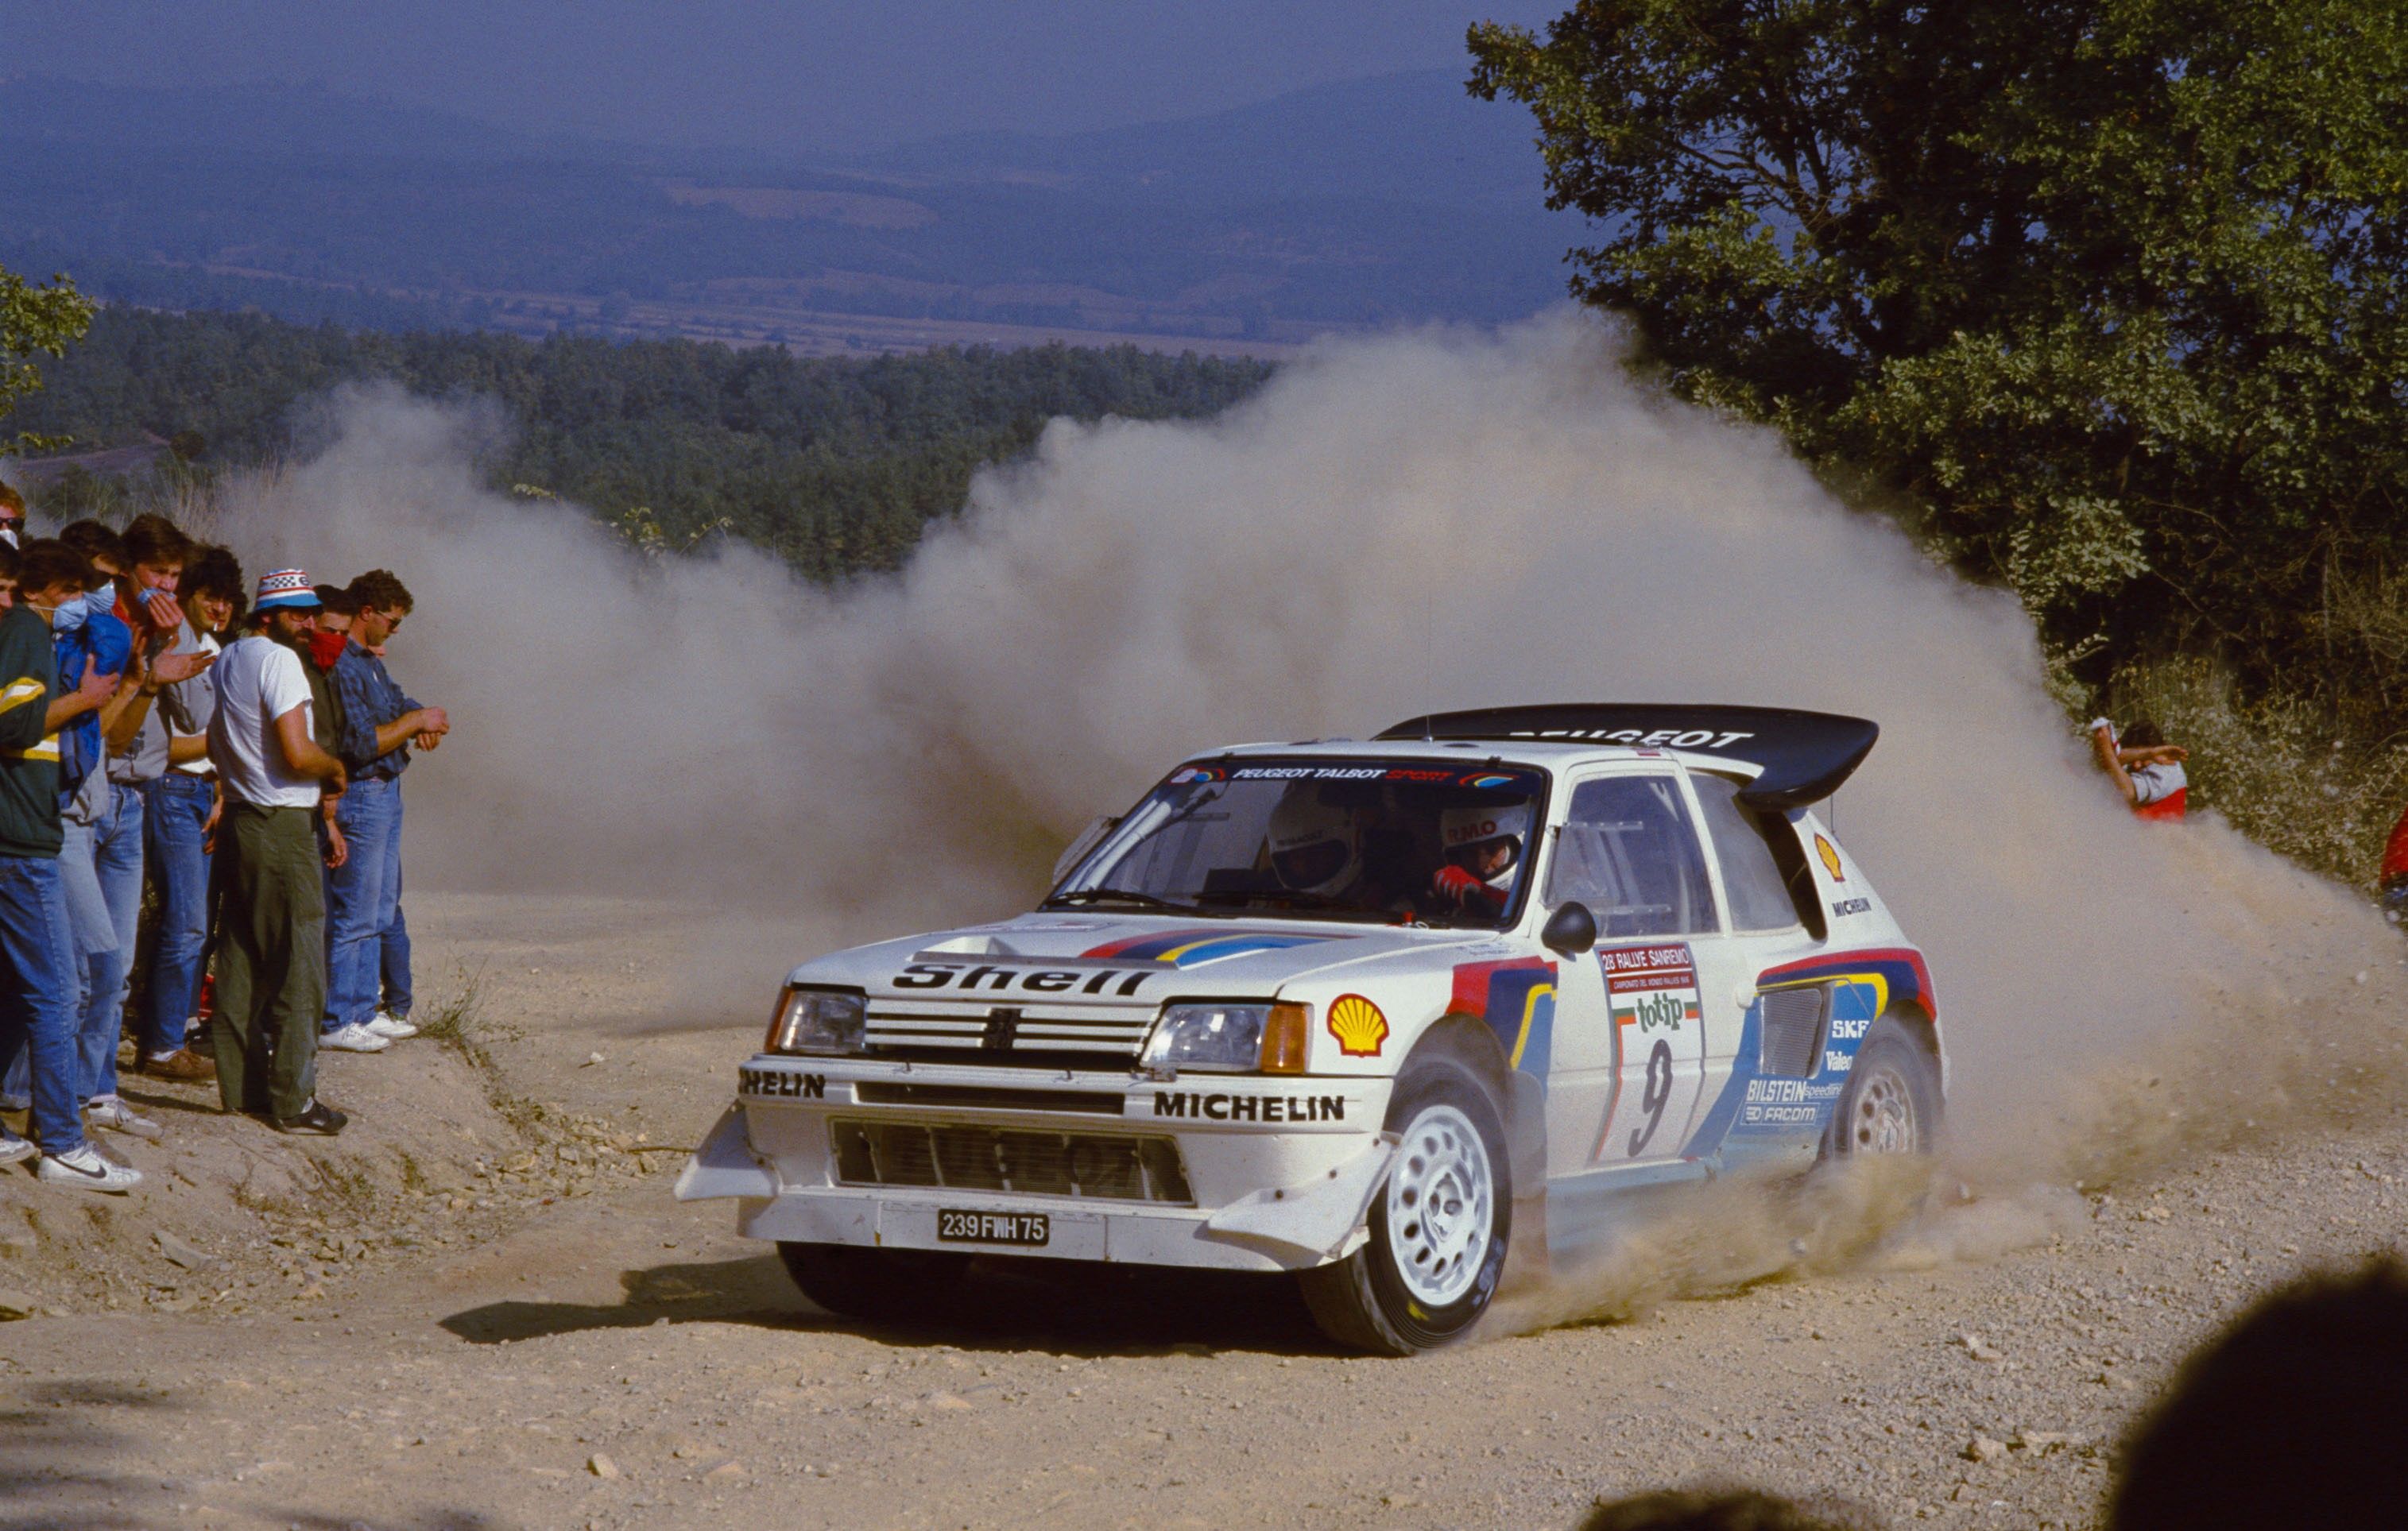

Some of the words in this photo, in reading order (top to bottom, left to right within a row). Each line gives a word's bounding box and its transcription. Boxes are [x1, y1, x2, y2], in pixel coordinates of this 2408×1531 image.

[1510, 729, 1755, 748] GEOT
[1233, 767, 1314, 779] PEUGEOT
[1313, 767, 1388, 779] TALBOT
[1385, 769, 1454, 782] SPORT
[1832, 897, 1872, 918] MICHELIN
[1616, 951, 1647, 968] RALLYE
[1649, 949, 1689, 966] SANREMO
[892, 964, 1156, 996] Shell
[1637, 992, 1682, 1033] totip
[1832, 1020, 1869, 1038] SKF
[1825, 1051, 1853, 1071] Valeo
[737, 1067, 826, 1099] HELIN
[1747, 1080, 1807, 1102] BILSTEIN
[1154, 1091, 1345, 1123] MICHELIN
[1628, 1038, 1673, 1157] 9
[1764, 1106, 1816, 1121] FACOM
